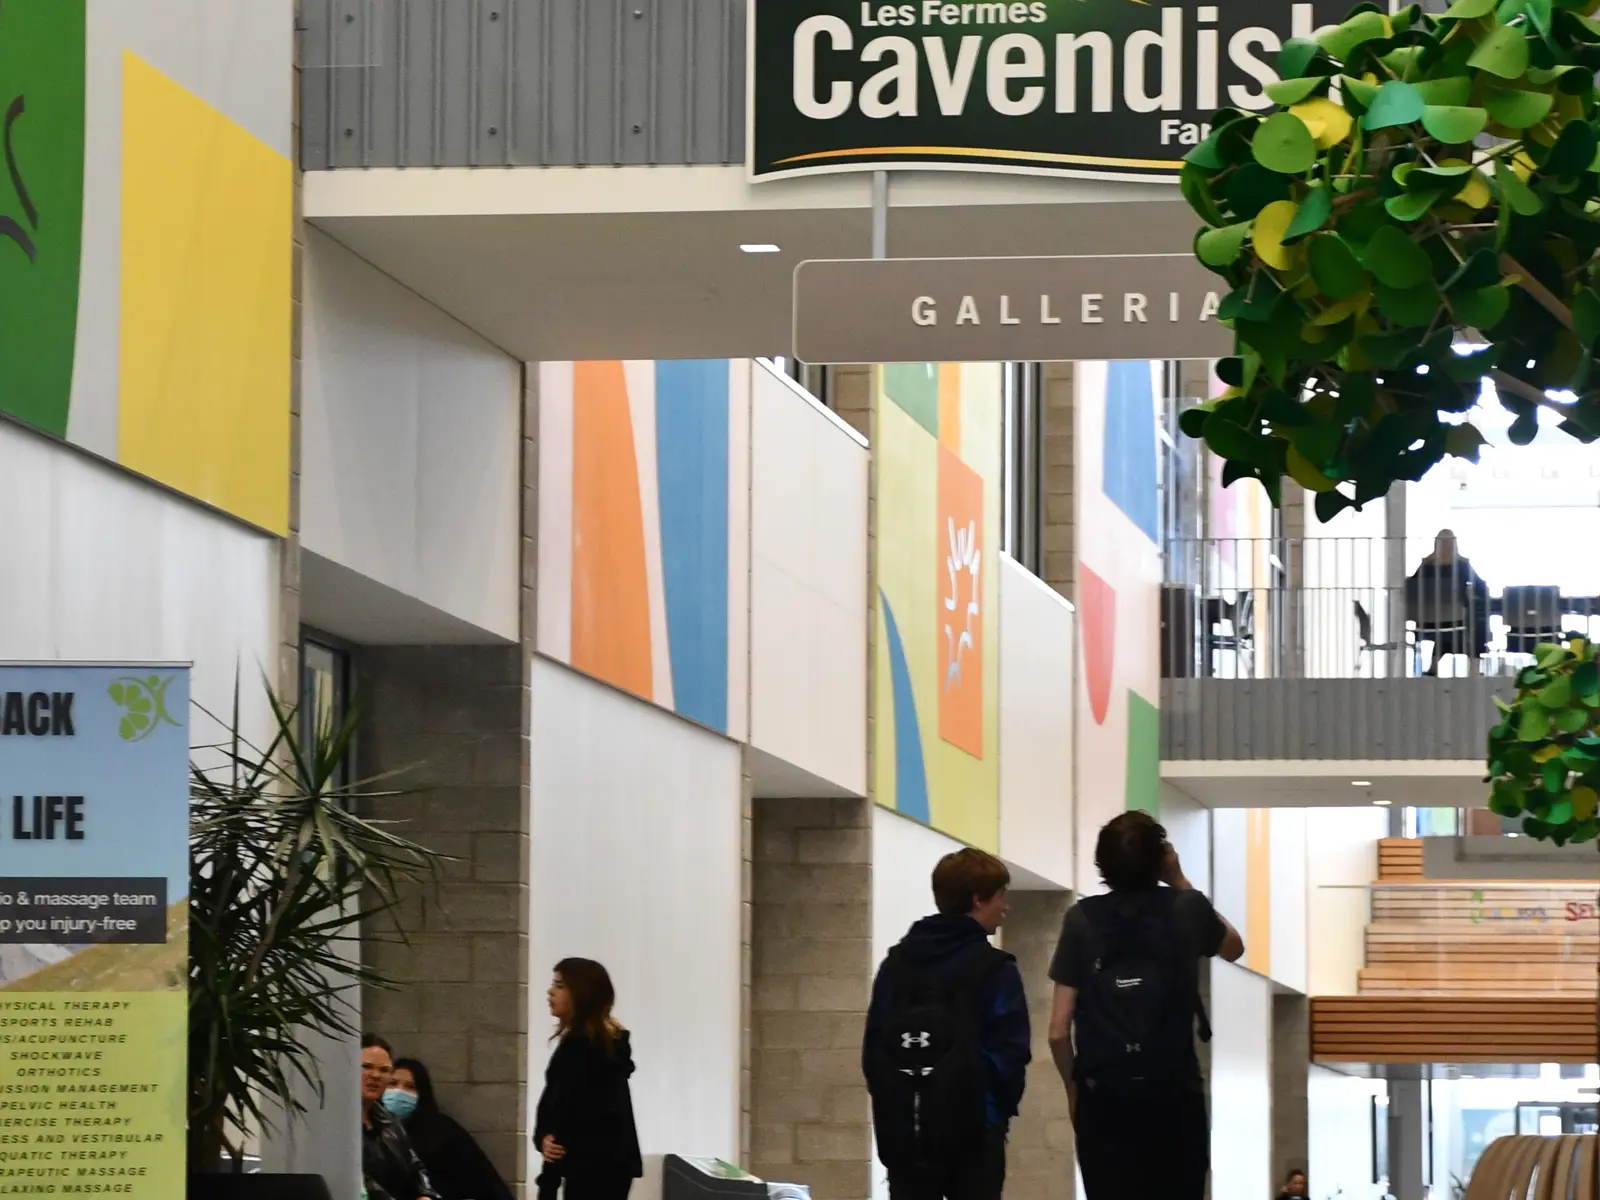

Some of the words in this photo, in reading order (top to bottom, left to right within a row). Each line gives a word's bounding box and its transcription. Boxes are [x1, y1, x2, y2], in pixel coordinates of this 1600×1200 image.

[861, 2, 916, 27] Les
[922, 0, 1048, 26] Fermes
[1160, 119, 1213, 145] Far
[911, 291, 1219, 326] GALLERIA
[0, 691, 75, 736] ACK
[13, 796, 84, 839] LIFE
[17, 891, 31, 906] &
[34, 894, 109, 909] massage
[113, 892, 157, 906] team
[15, 919, 47, 934] you
[50, 916, 137, 935] injury-free
[0, 1001, 56, 1011] YSICAL
[63, 1001, 131, 1011] THERAPY
[0, 1018, 57, 1027] SPORTS
[64, 1018, 113, 1027] REHAB
[0, 1034, 128, 1044] S/ACUPUNCTURE
[10, 1051, 103, 1061] SHOCKWAVE
[16, 1068, 101, 1077] ORTHOTICS
[56, 1083, 159, 1093] MANAGEMENT
[0, 1101, 53, 1110] PELVIC
[58, 1101, 118, 1110] HEALTH
[0, 1118, 57, 1127] ERCISE
[65, 1117, 132, 1127] THERAPY
[35, 1134, 65, 1144] AND
[72, 1133, 163, 1143] VESTIBULAR
[60, 1150, 128, 1160] THERAPY
[77, 1167, 148, 1177] MASSAGE
[61, 1183, 133, 1193] MASSAGE
